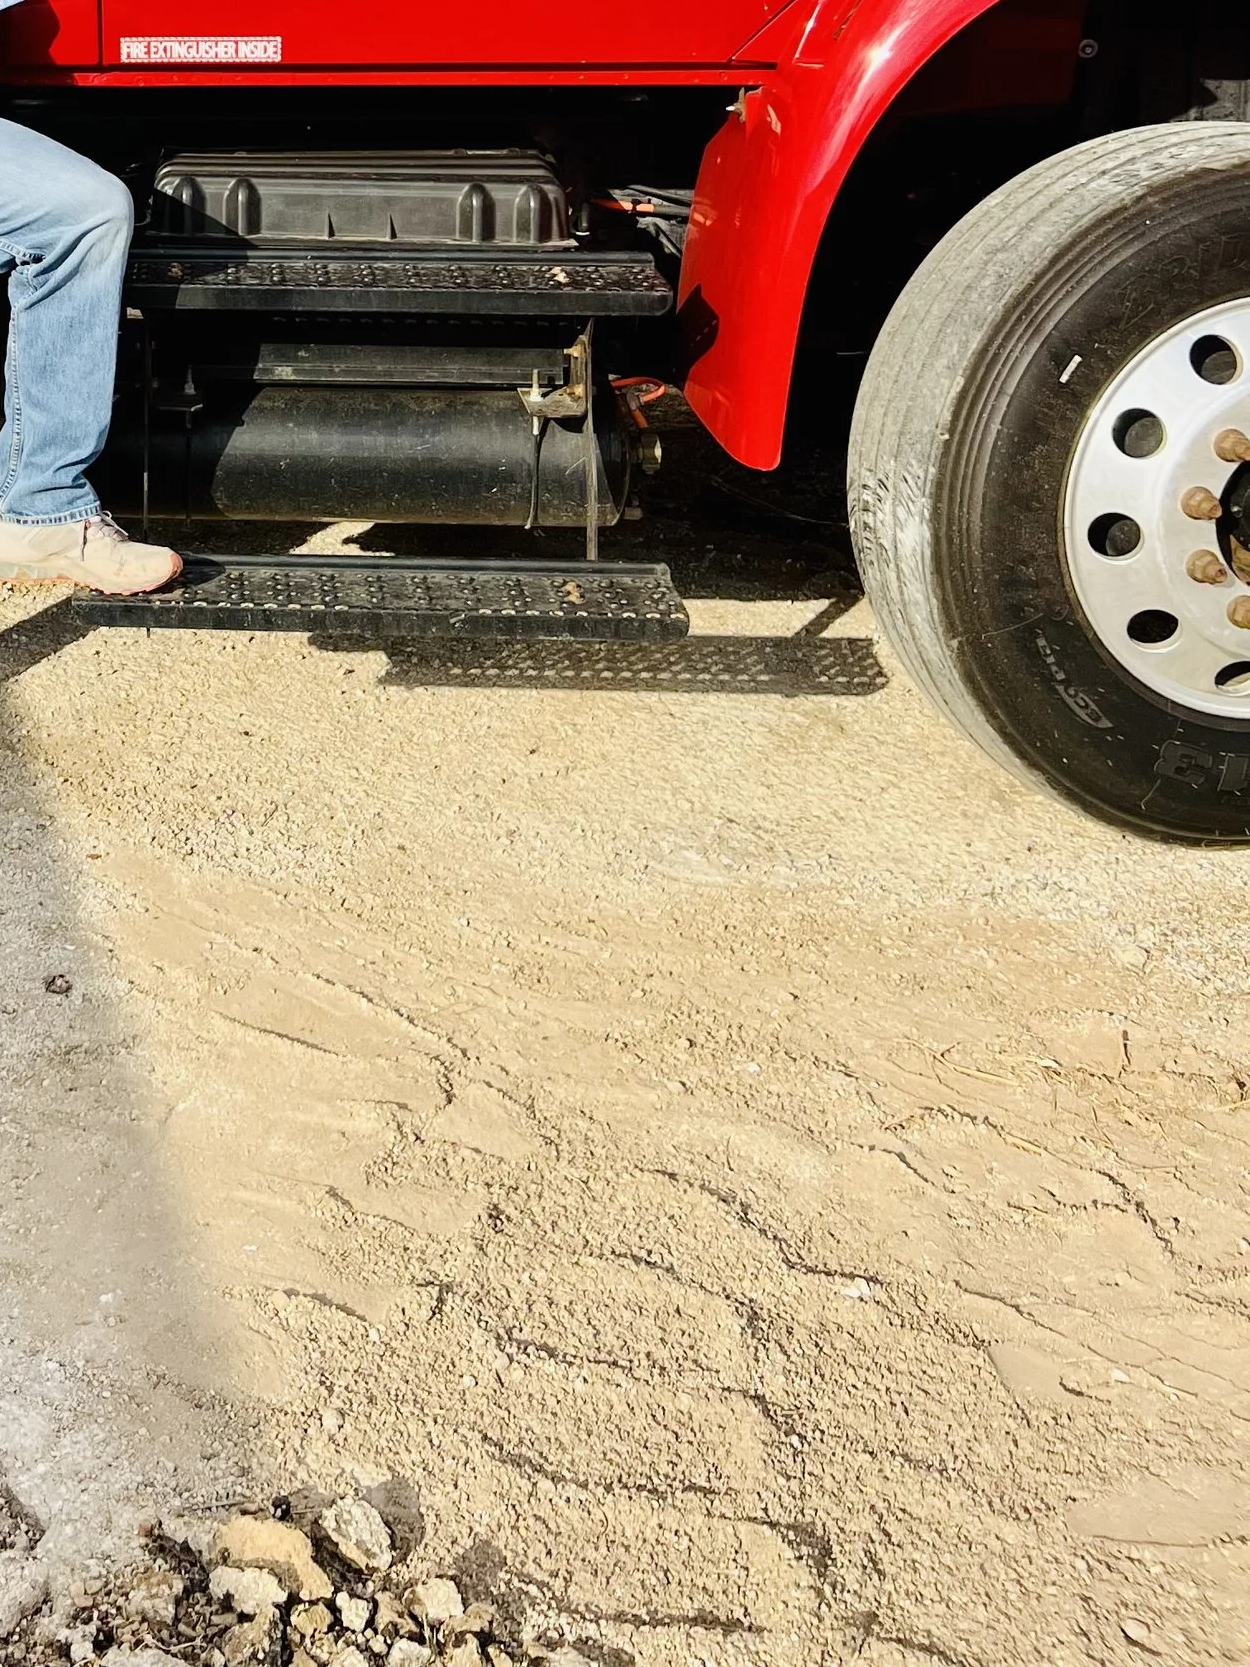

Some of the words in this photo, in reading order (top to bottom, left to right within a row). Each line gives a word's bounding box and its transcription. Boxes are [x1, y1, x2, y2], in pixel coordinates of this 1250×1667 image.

[123, 41, 148, 59] FIRE
[150, 40, 236, 59] EXTINGUISHER
[238, 40, 278, 58] INSIDE
